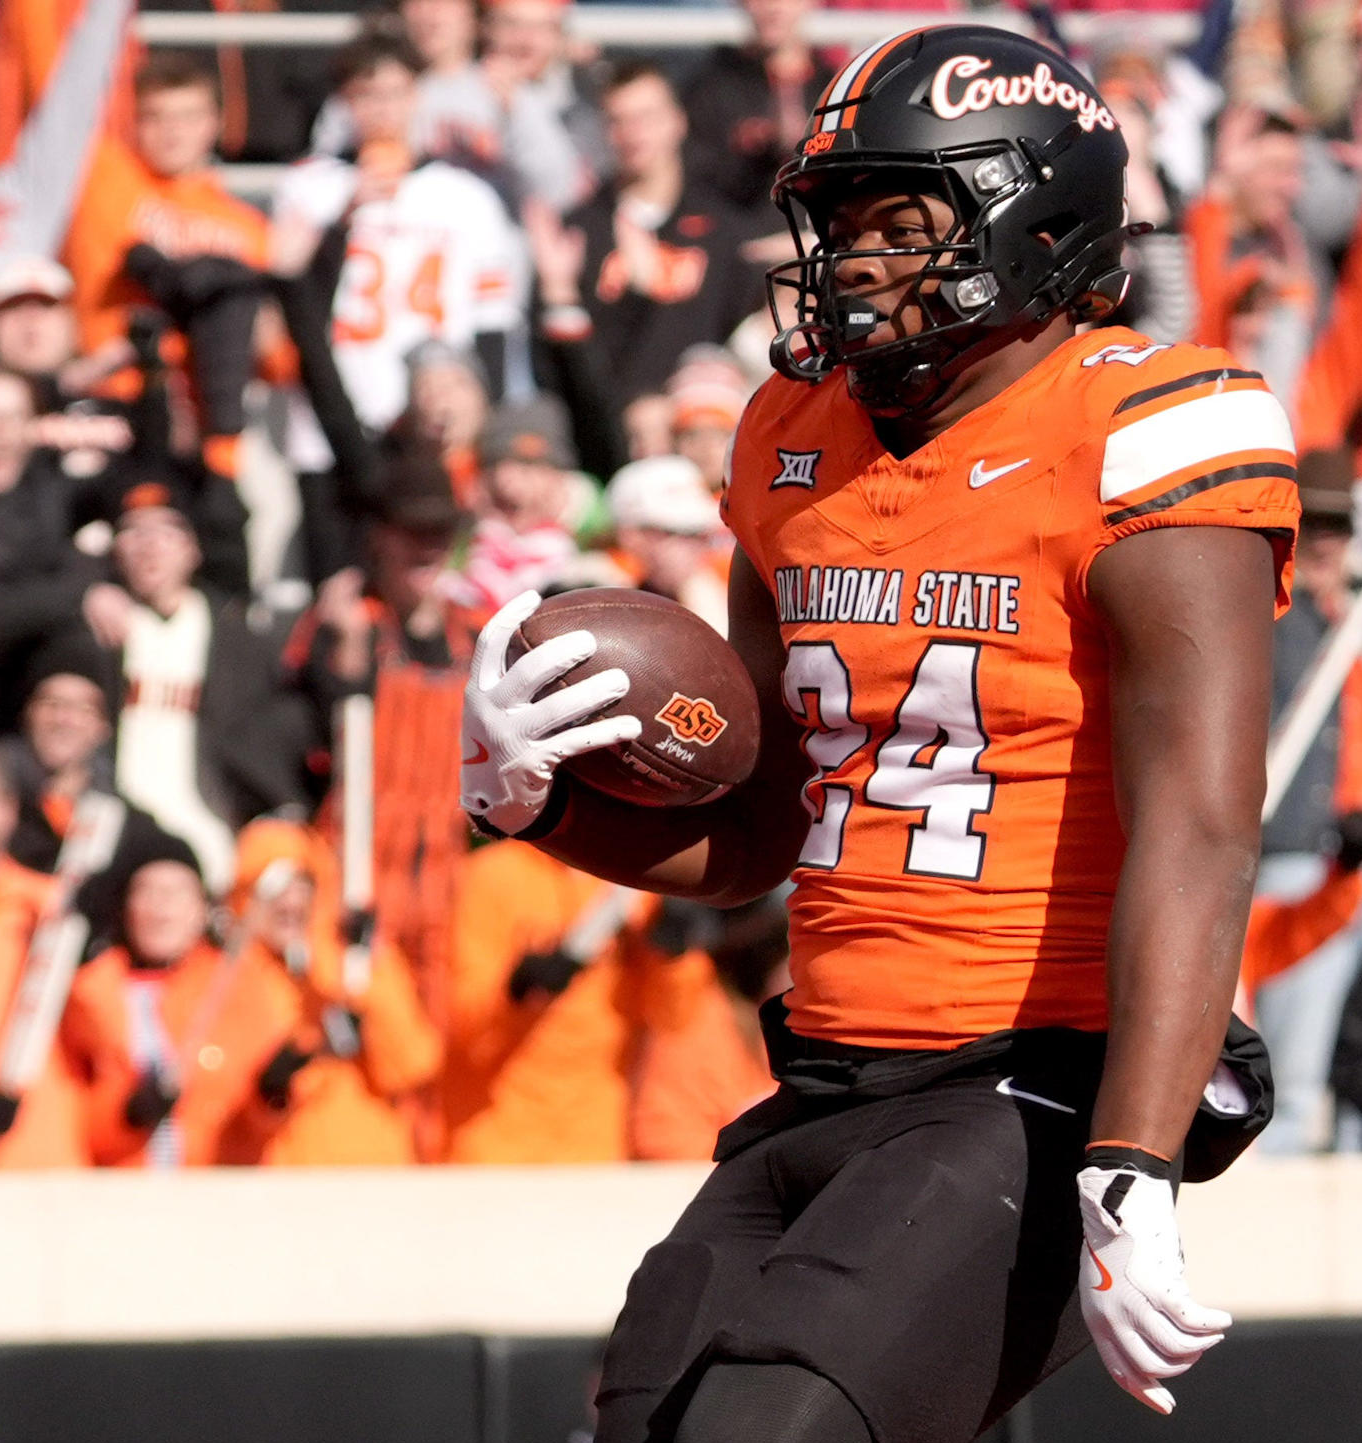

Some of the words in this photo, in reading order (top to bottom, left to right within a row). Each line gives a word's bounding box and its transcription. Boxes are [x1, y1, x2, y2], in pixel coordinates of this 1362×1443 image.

[931, 55, 1117, 132] Cowboys
[769, 449, 822, 490] XII
[775, 565, 903, 624] OKLAHOMA
[913, 568, 1020, 634] STATE
[784, 638, 997, 882] 24
